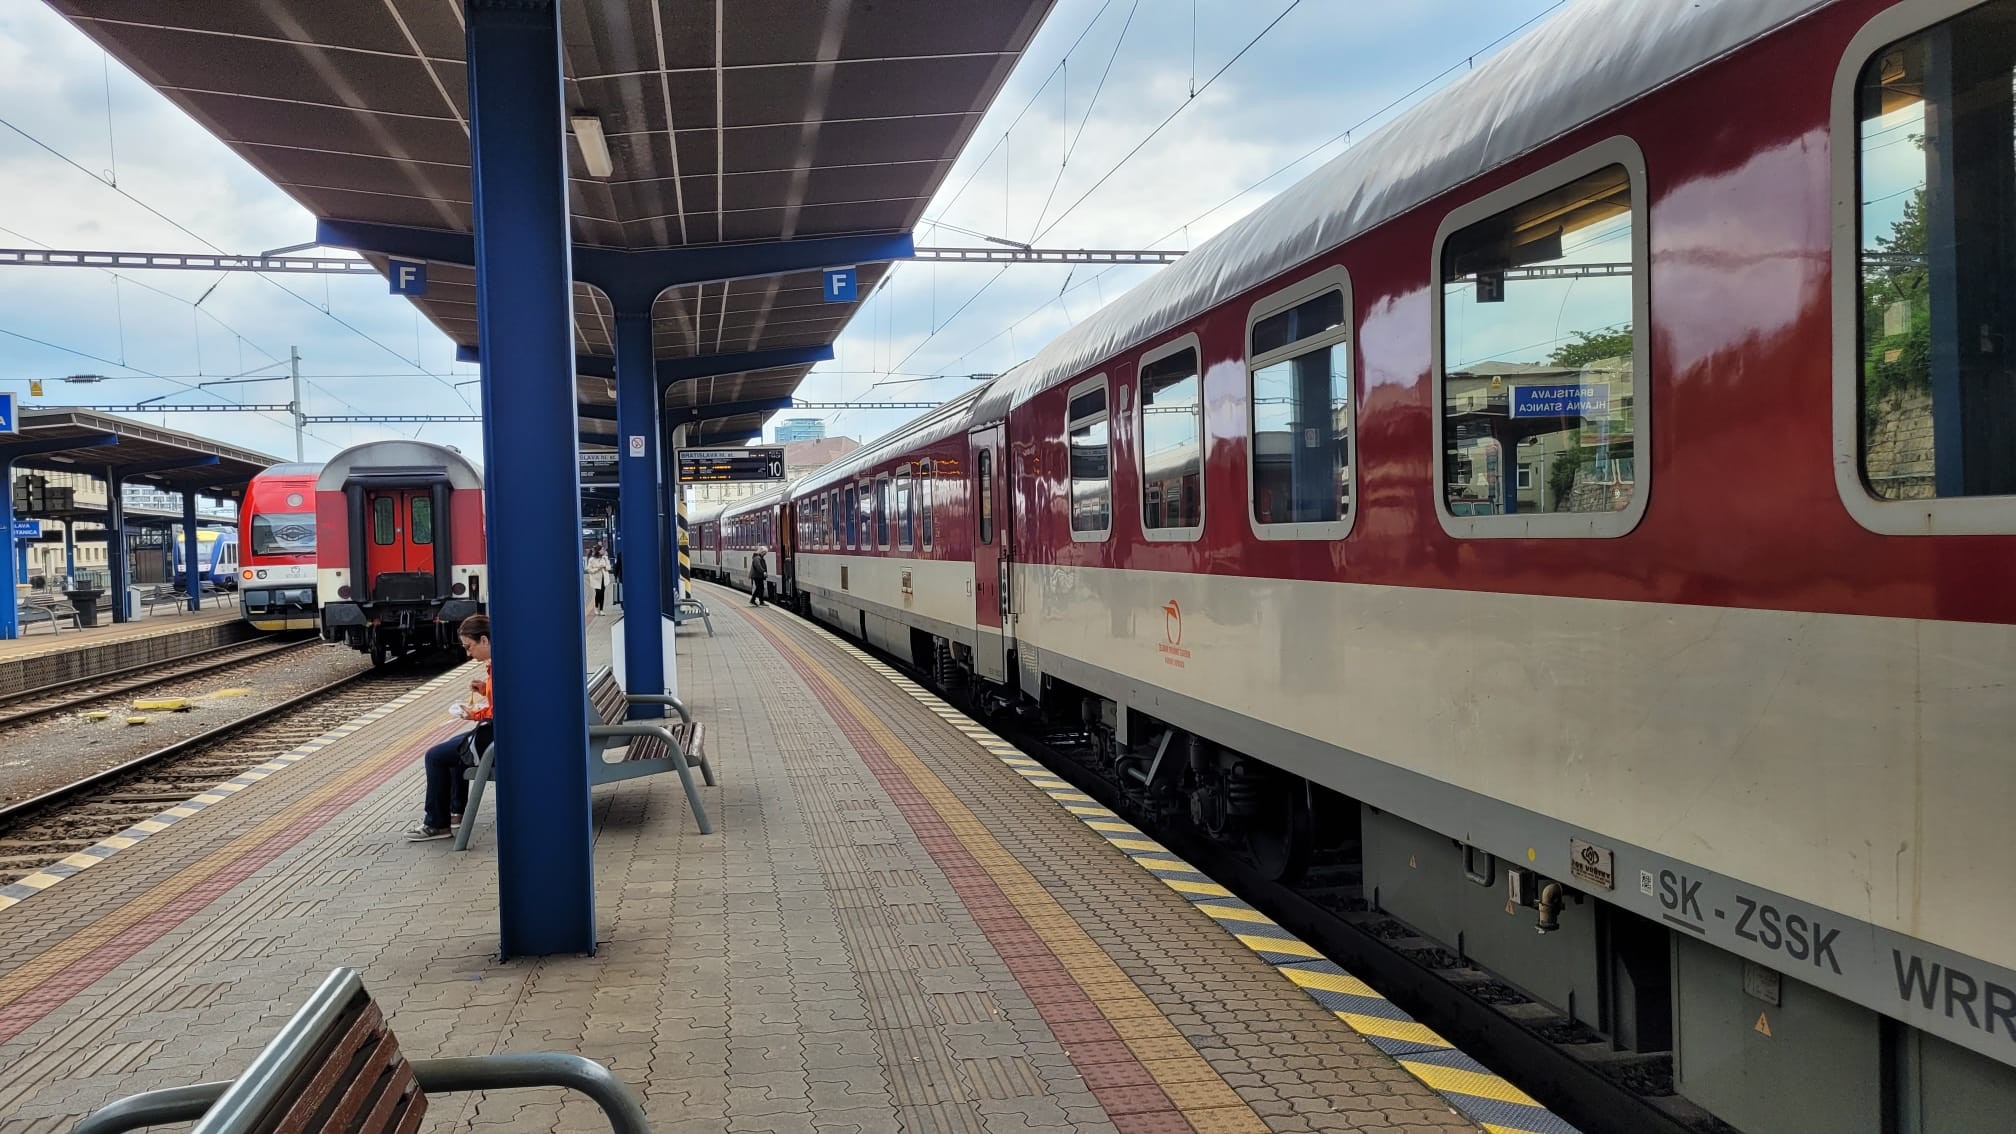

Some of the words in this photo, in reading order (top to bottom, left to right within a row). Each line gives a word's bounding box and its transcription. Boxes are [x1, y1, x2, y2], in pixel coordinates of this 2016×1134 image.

[400, 266, 417, 289] F
[832, 274, 847, 295] F
[768, 461, 782, 477] 10
[1658, 869, 1704, 922] SK
[1734, 895, 1843, 975] ZSSK
[1893, 948, 2016, 1044] WRR
